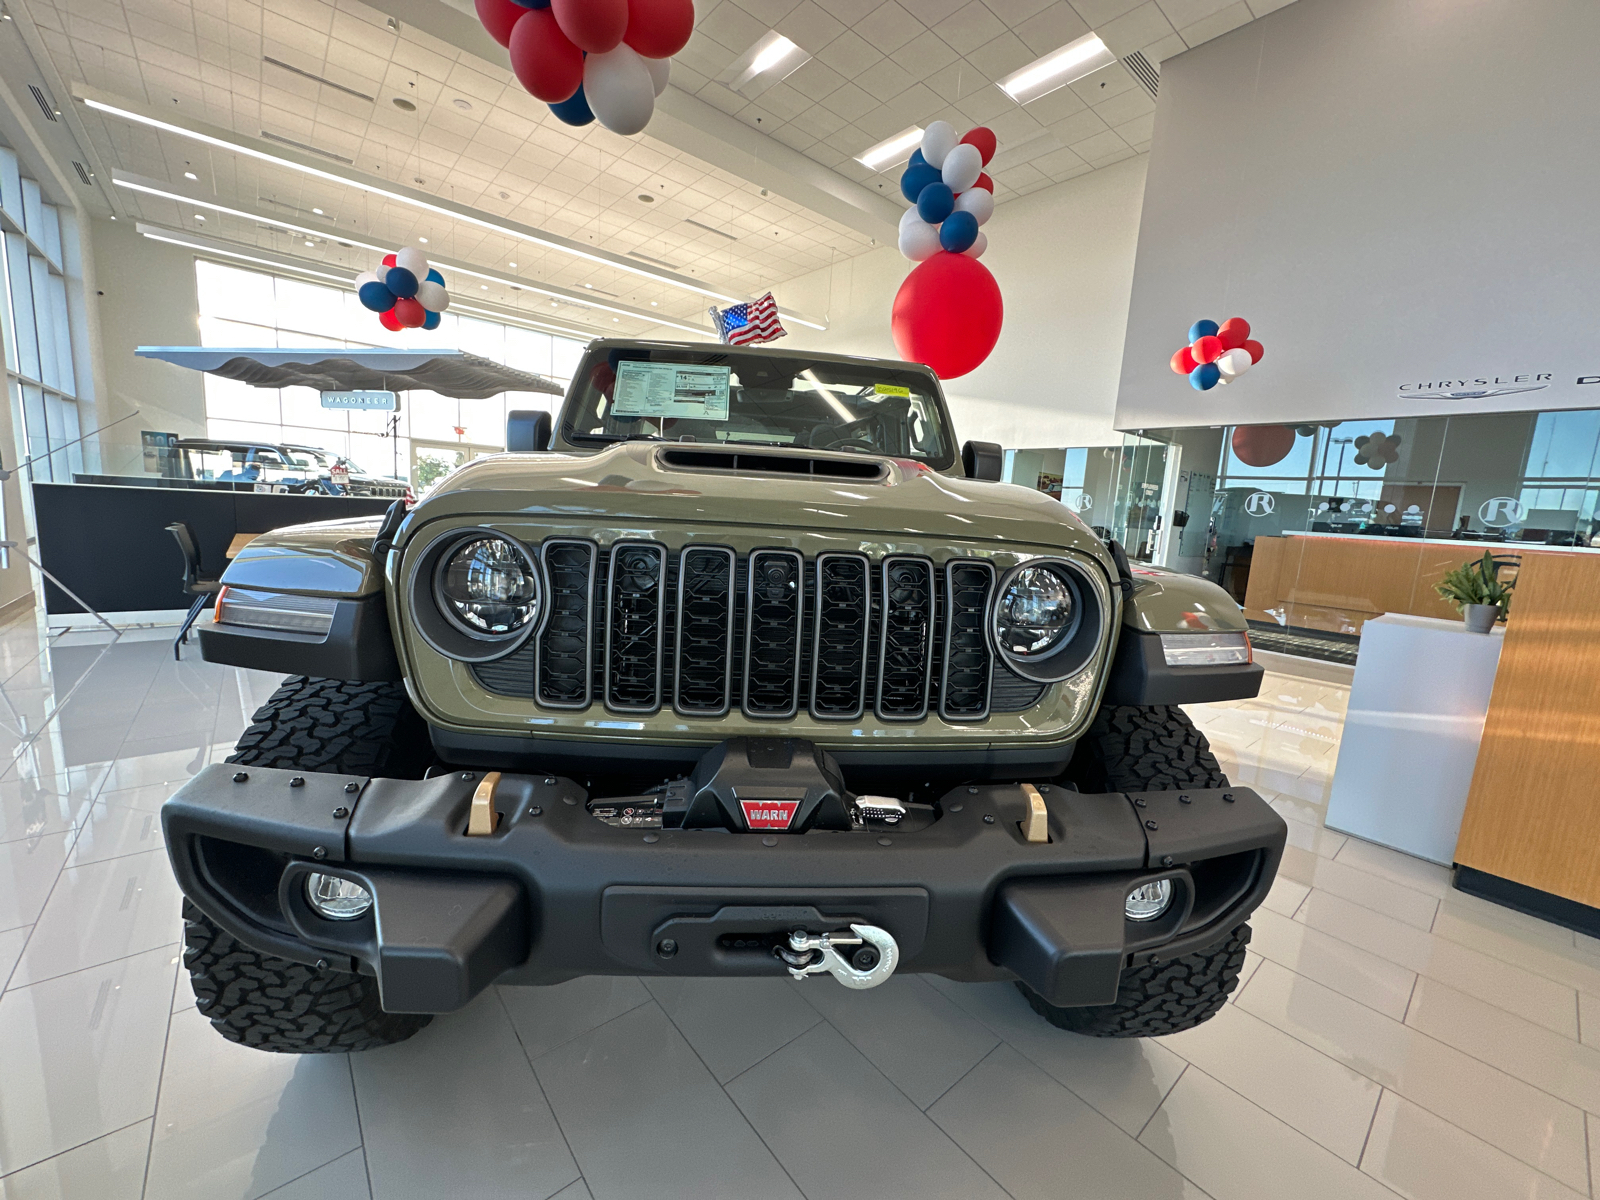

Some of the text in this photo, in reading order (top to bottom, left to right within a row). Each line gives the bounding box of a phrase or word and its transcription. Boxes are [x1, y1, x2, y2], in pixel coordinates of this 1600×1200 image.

[1399, 373, 1552, 391] CHRYSLER
[327, 396, 388, 405] WAGONEER
[1247, 493, 1275, 515] R
[1482, 498, 1523, 525] R
[750, 809, 788, 820] WARN
